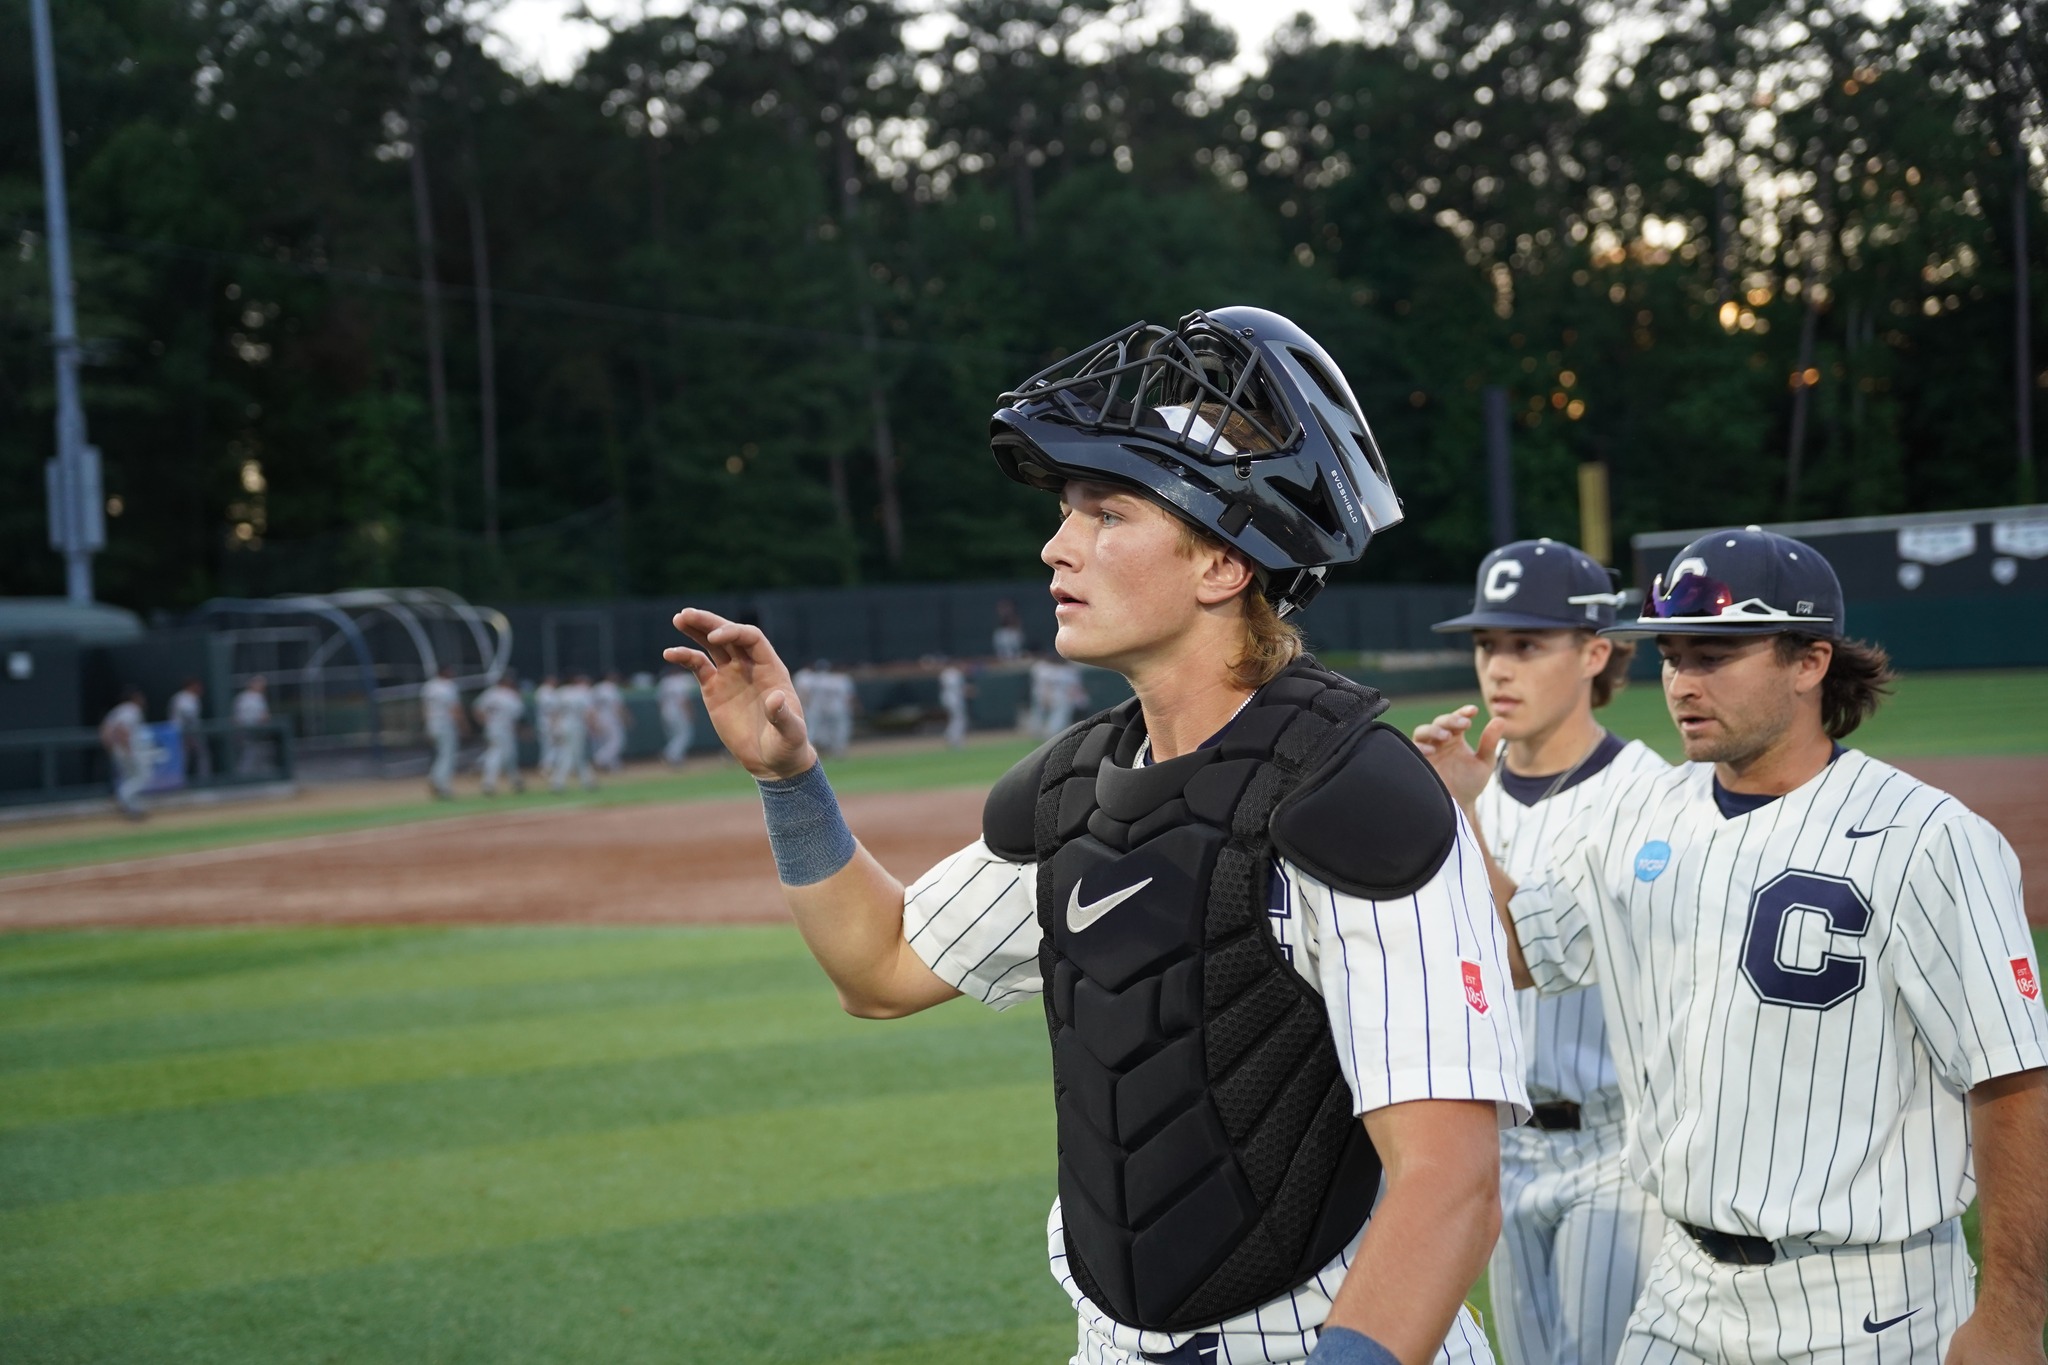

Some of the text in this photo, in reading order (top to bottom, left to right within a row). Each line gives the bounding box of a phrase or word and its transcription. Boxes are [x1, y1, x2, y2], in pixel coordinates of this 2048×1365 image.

[1331, 470, 1358, 523] EVOSHIELD
[1484, 559, 1523, 602] C
[1738, 868, 1874, 1011] C
[1465, 985, 1487, 1009] 1851
